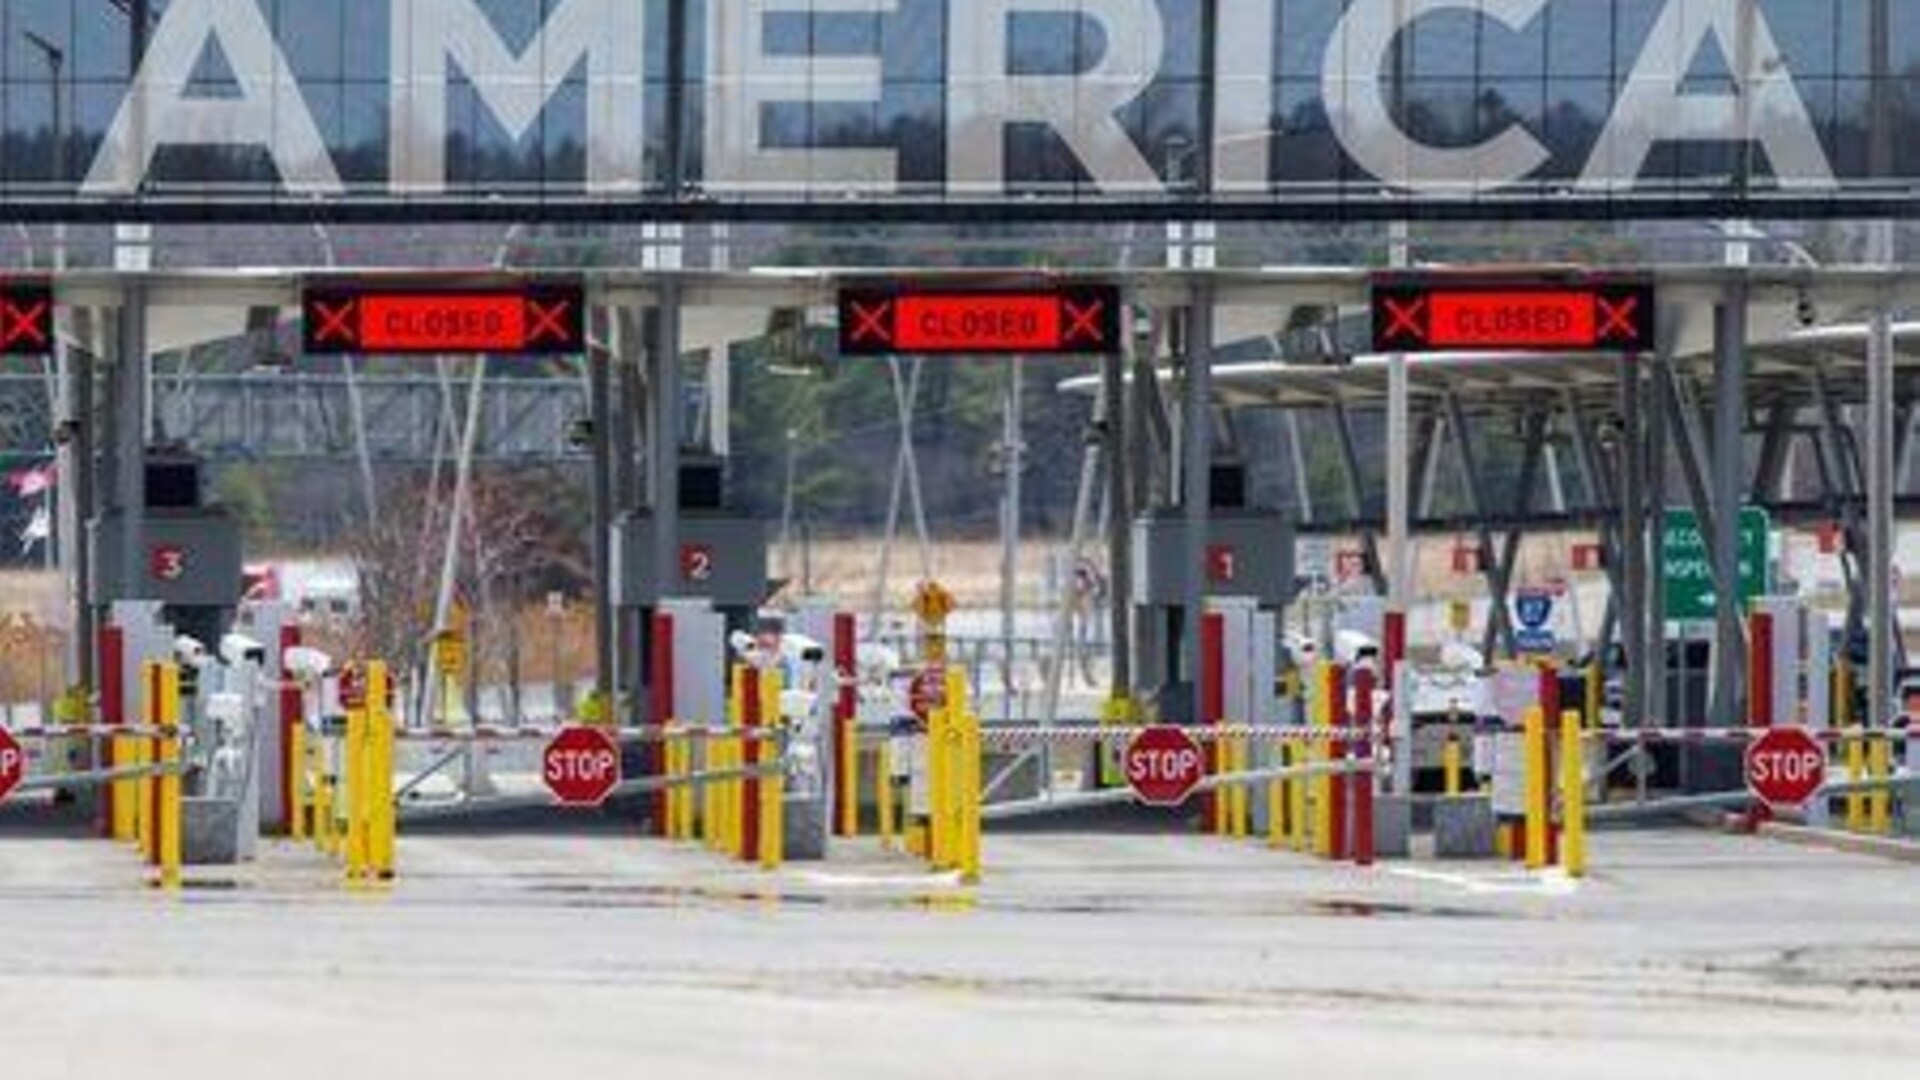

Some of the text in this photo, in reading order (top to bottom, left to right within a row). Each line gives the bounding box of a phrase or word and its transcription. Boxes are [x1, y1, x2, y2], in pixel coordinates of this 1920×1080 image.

[79, 0, 1838, 196] AMERICA
[385, 310, 503, 336] CLOSED
[919, 310, 1037, 336] CLOSED
[1456, 307, 1572, 332] CLOSED
[161, 552, 182, 579] 3
[691, 552, 711, 579] 2
[1220, 552, 1233, 579] 1
[547, 749, 613, 779] STOP
[1130, 749, 1196, 779] STOP
[1751, 749, 1821, 779] STOP
